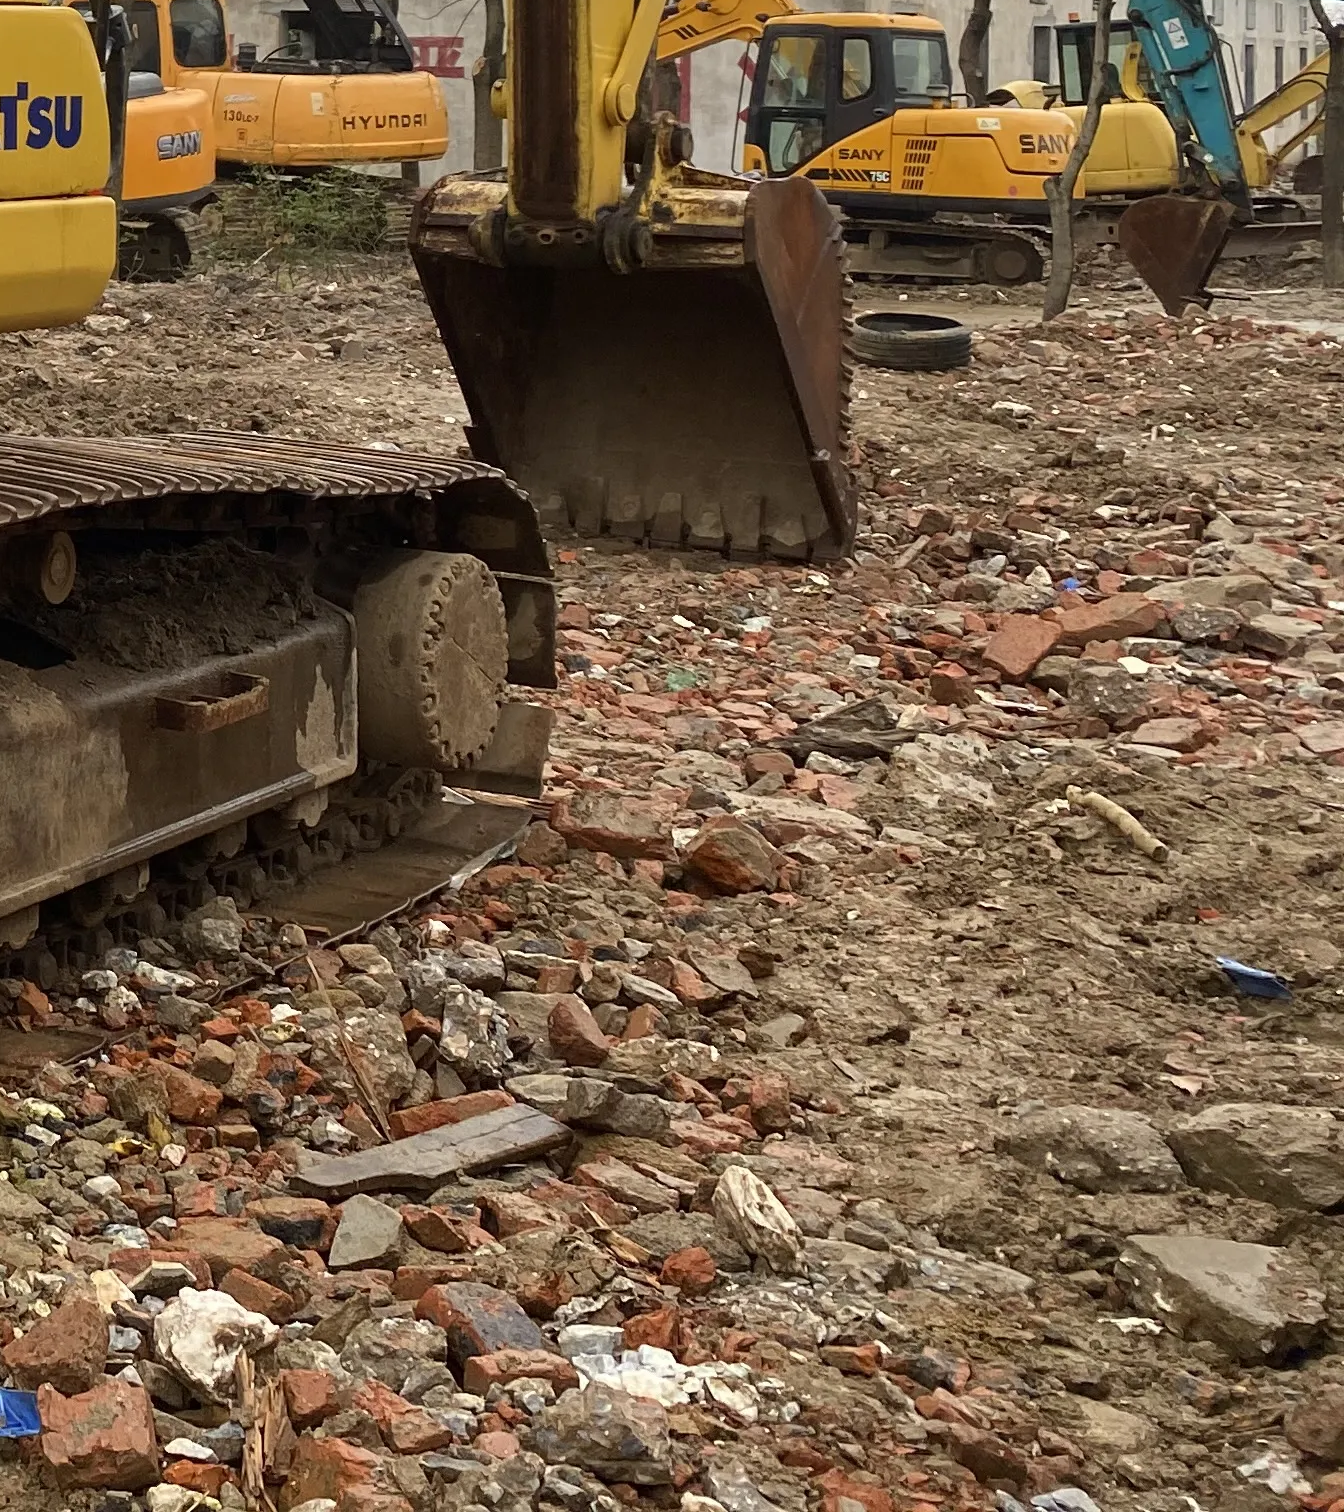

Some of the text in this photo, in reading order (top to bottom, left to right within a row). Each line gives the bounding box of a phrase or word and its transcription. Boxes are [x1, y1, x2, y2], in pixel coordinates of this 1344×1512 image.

[342, 113, 427, 131] HYUNDAI
[157, 131, 202, 161] SANY
[1019, 133, 1071, 155] SANY
[838, 148, 885, 161] SANY
[870, 170, 890, 183] 75C
